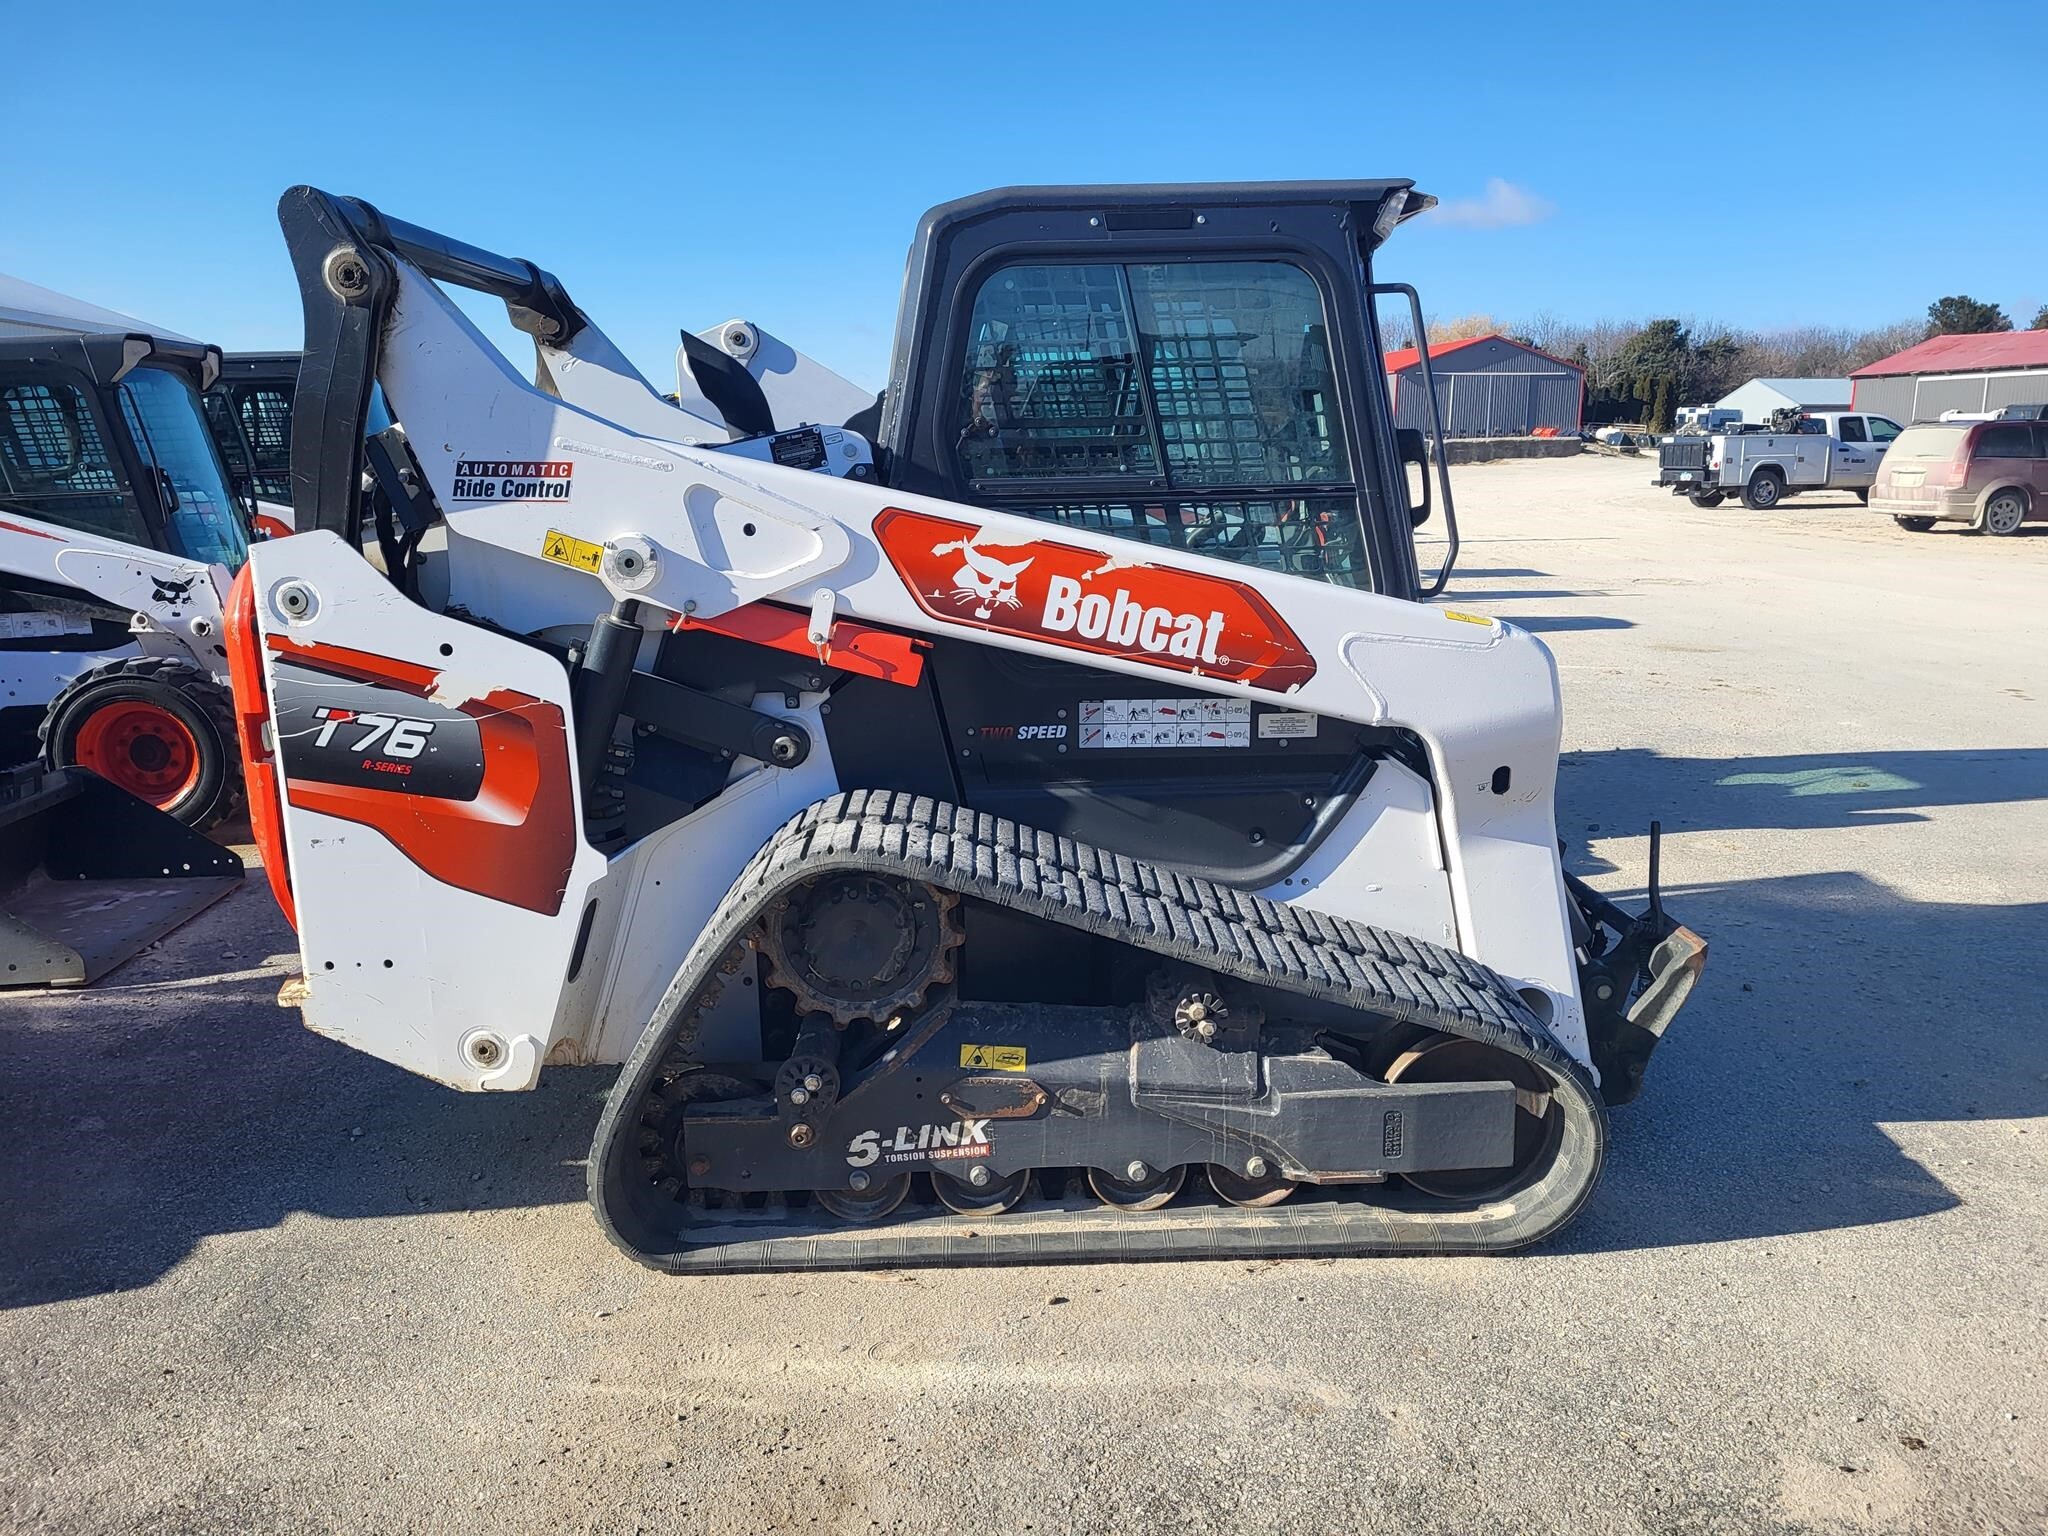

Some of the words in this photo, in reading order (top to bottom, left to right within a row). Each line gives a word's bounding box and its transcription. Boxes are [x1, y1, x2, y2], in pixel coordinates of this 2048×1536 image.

[460, 463, 569, 476] AUTOMATIC
[453, 479, 496, 498] Ride
[501, 479, 571, 498] Control
[1041, 575, 1224, 664] Bobcat
[314, 707, 436, 759] T76
[980, 726, 1014, 738] TWO
[1017, 725, 1067, 739] SPEED
[362, 760, 412, 775] R-SERIES
[885, 1152, 925, 1163] TORSION
[928, 1146, 987, 1160] SUSPENSION
